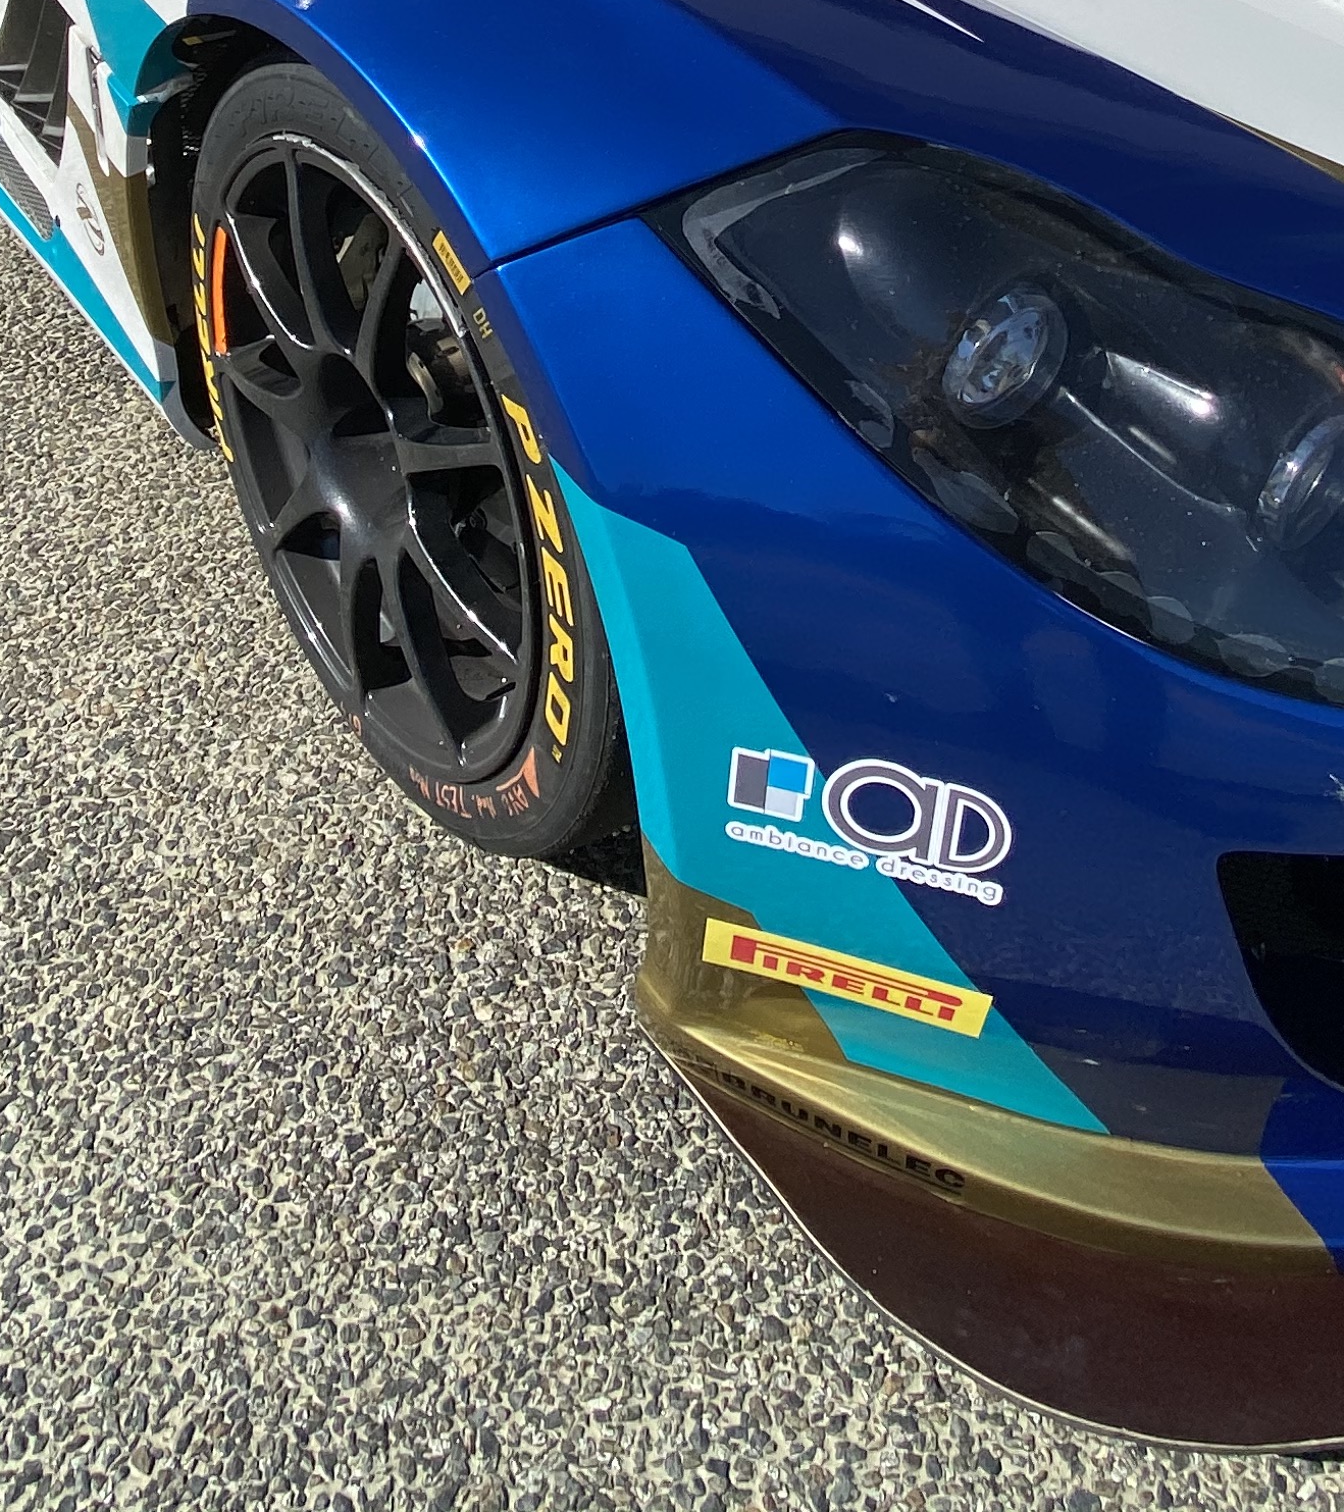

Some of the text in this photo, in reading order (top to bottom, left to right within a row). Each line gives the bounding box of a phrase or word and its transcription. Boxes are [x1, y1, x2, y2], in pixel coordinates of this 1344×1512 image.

[472, 307, 493, 339] DH
[501, 394, 542, 465] P
[729, 823, 997, 902] ambiance dressing
[730, 935, 964, 1022] PIRELLI
